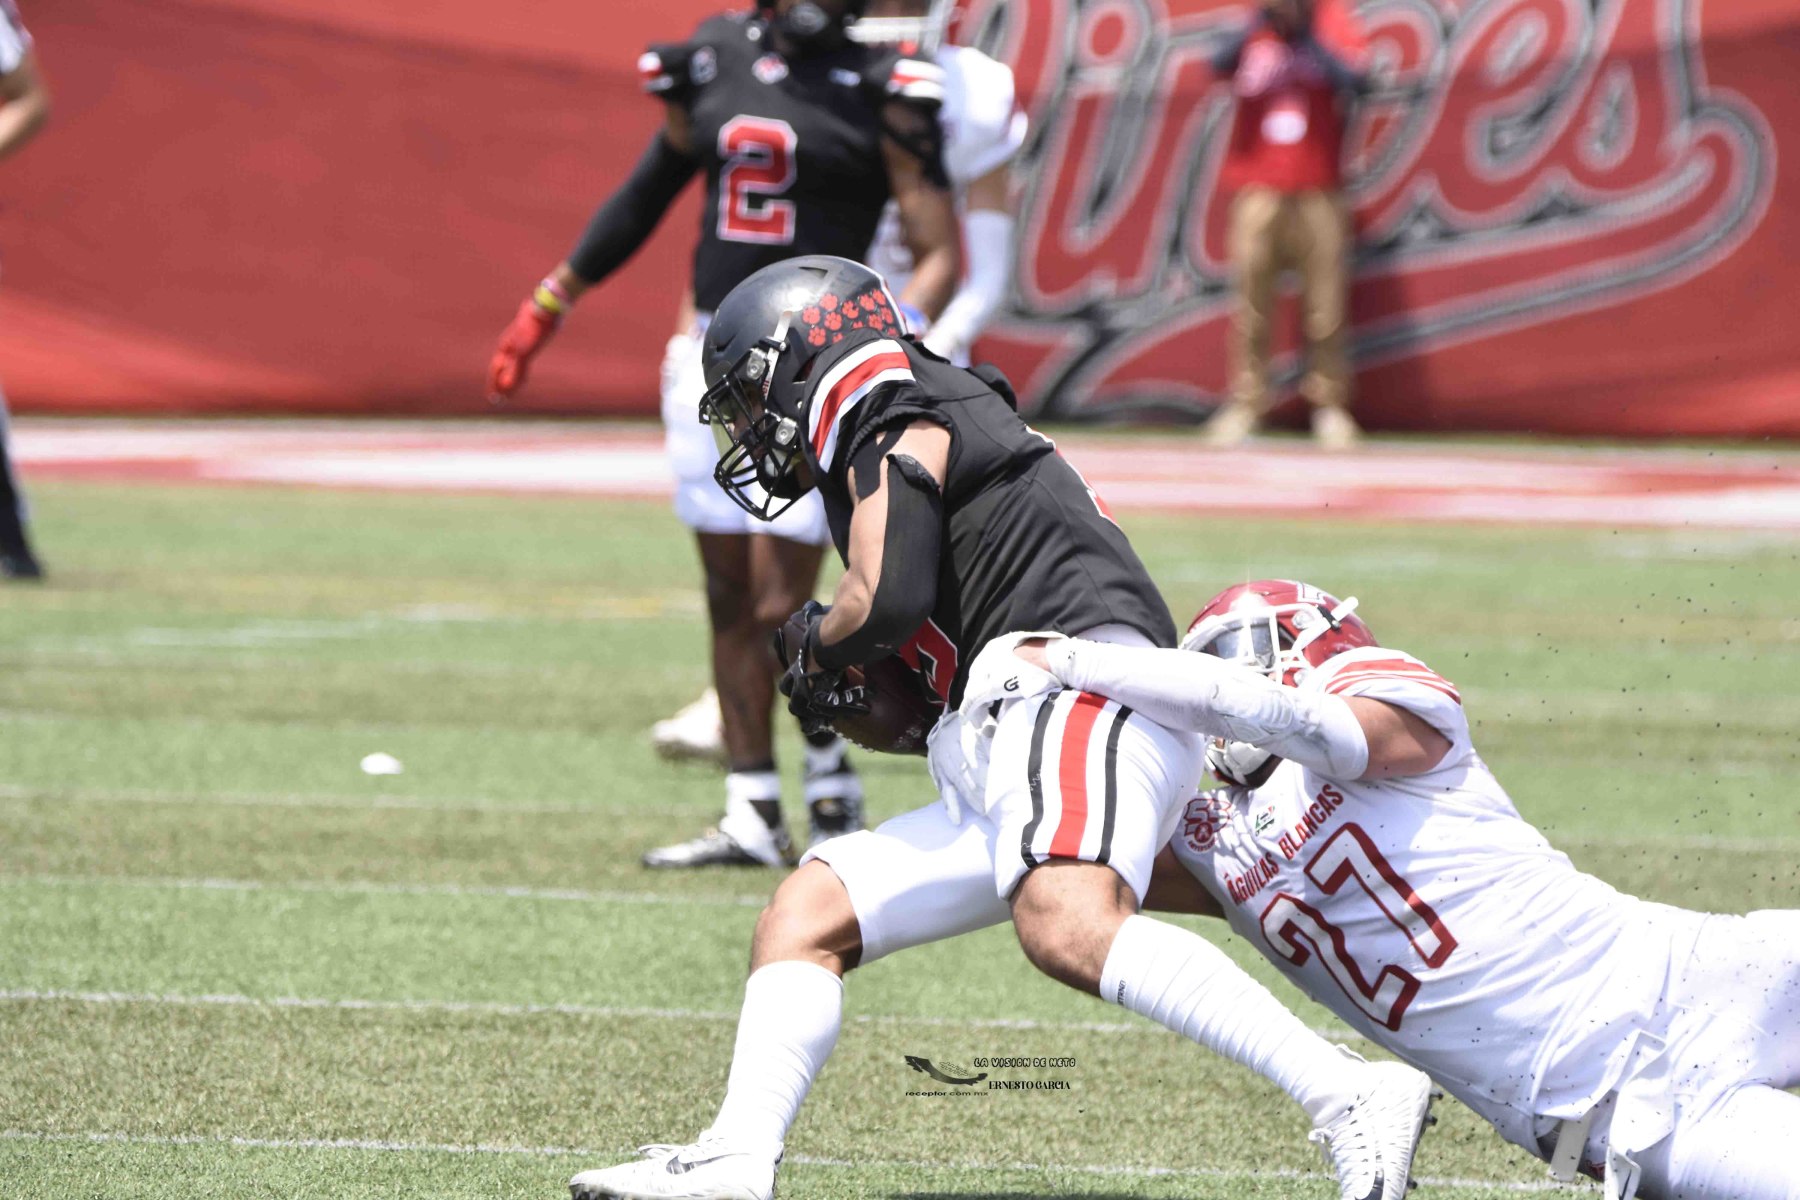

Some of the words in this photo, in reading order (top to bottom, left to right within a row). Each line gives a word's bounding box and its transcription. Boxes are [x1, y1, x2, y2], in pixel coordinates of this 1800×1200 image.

[716, 114, 798, 245] 2
[1224, 852, 1280, 905] ÁGUILAS
[1279, 784, 1344, 860] BLANCAS
[1259, 821, 1458, 1031] 27
